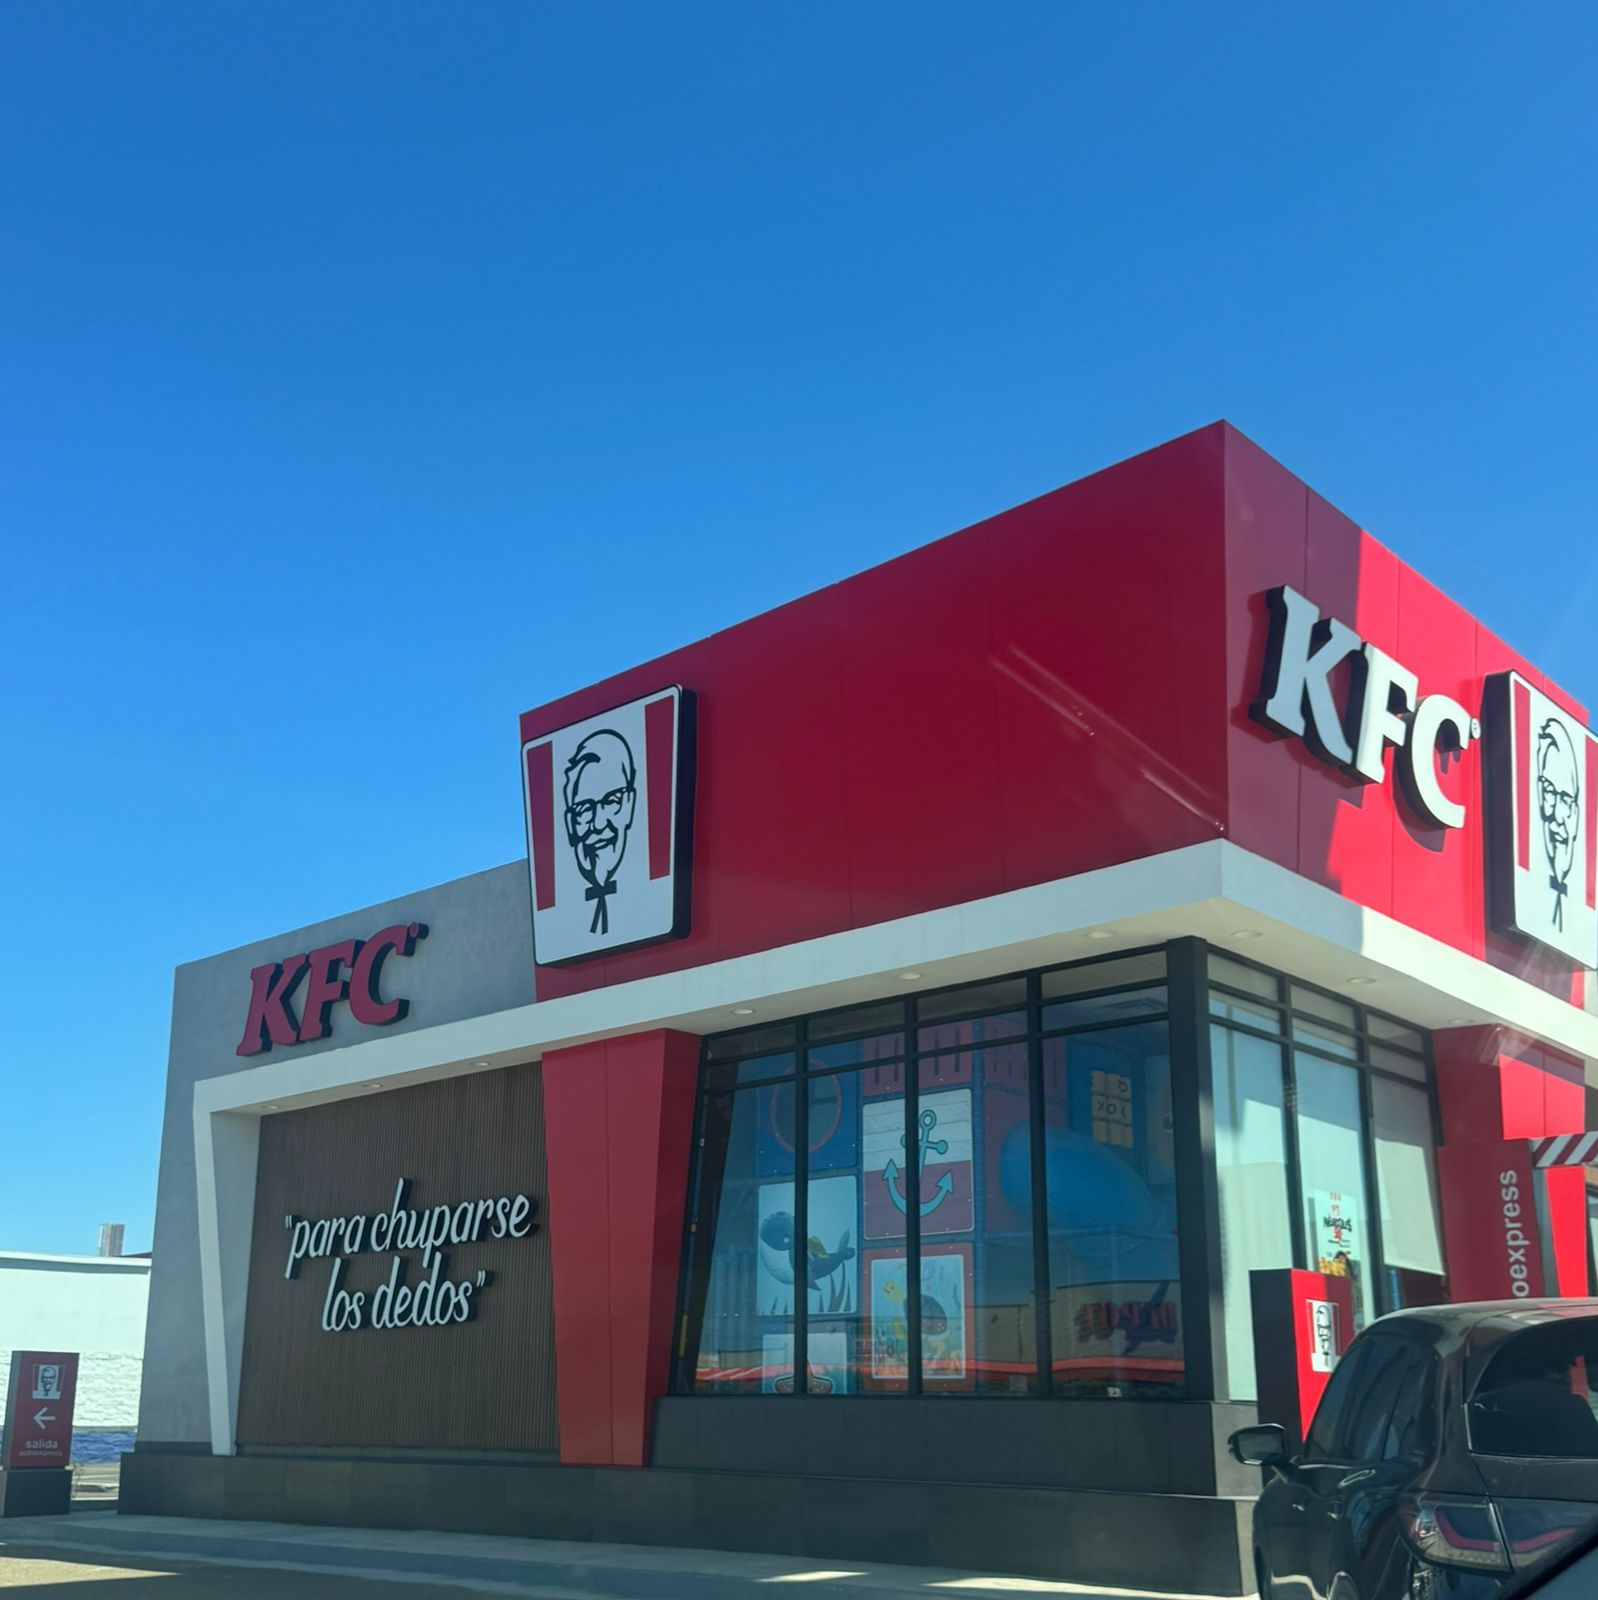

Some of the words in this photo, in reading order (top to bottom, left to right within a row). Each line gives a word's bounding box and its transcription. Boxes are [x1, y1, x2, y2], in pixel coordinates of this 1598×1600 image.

[370, 1177, 531, 1268] chuparse
[1500, 1170, 1530, 1297] oexpress
[322, 1257, 365, 1331] los
[25, 1439, 58, 1449] salida
